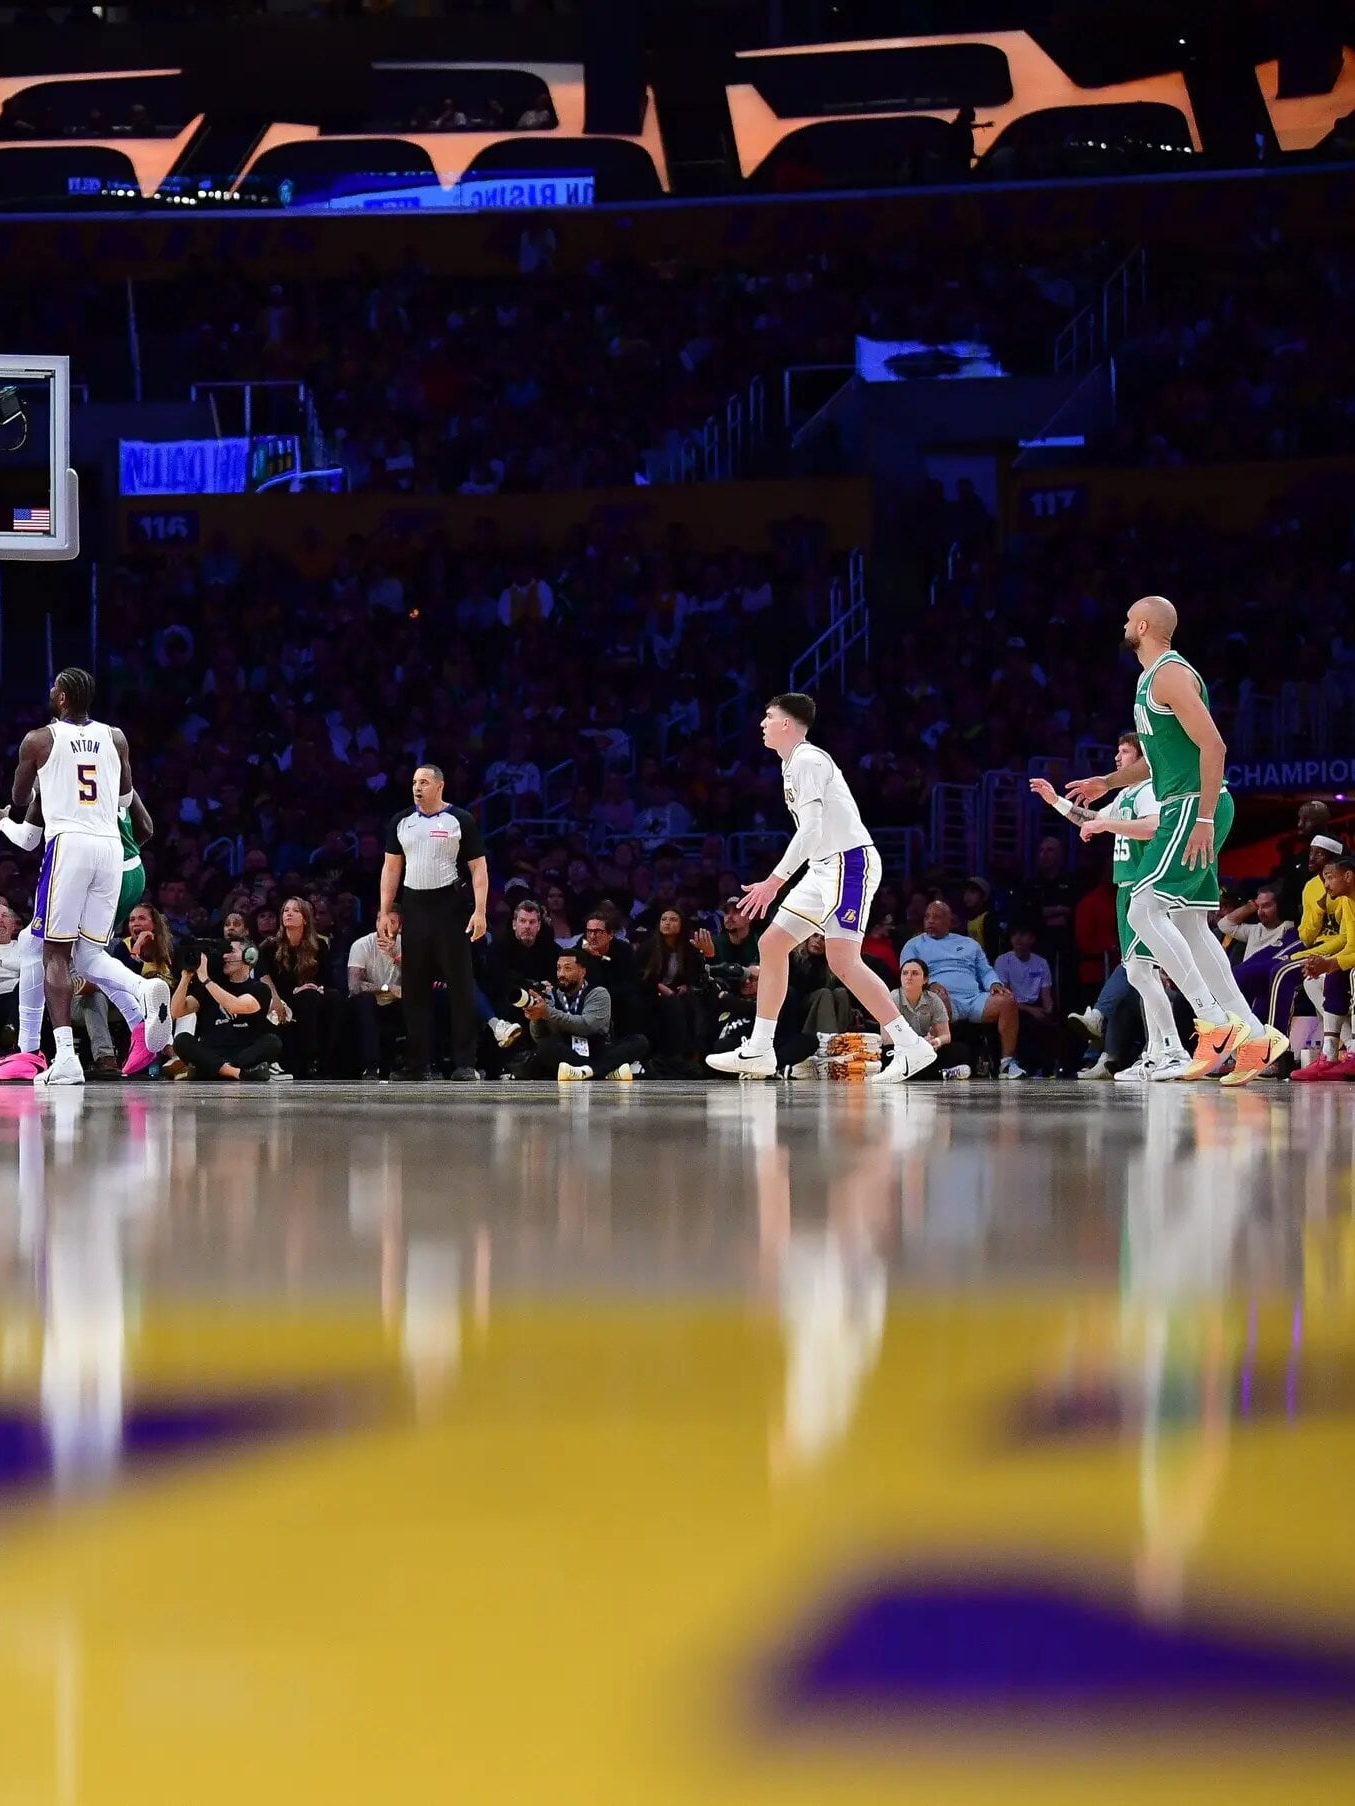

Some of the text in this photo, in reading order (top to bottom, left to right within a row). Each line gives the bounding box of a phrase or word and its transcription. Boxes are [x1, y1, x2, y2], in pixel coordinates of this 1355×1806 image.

[70, 739, 100, 754] AYTON
[77, 764, 98, 804] 5
[1226, 759, 1355, 787] CHAMPIO
